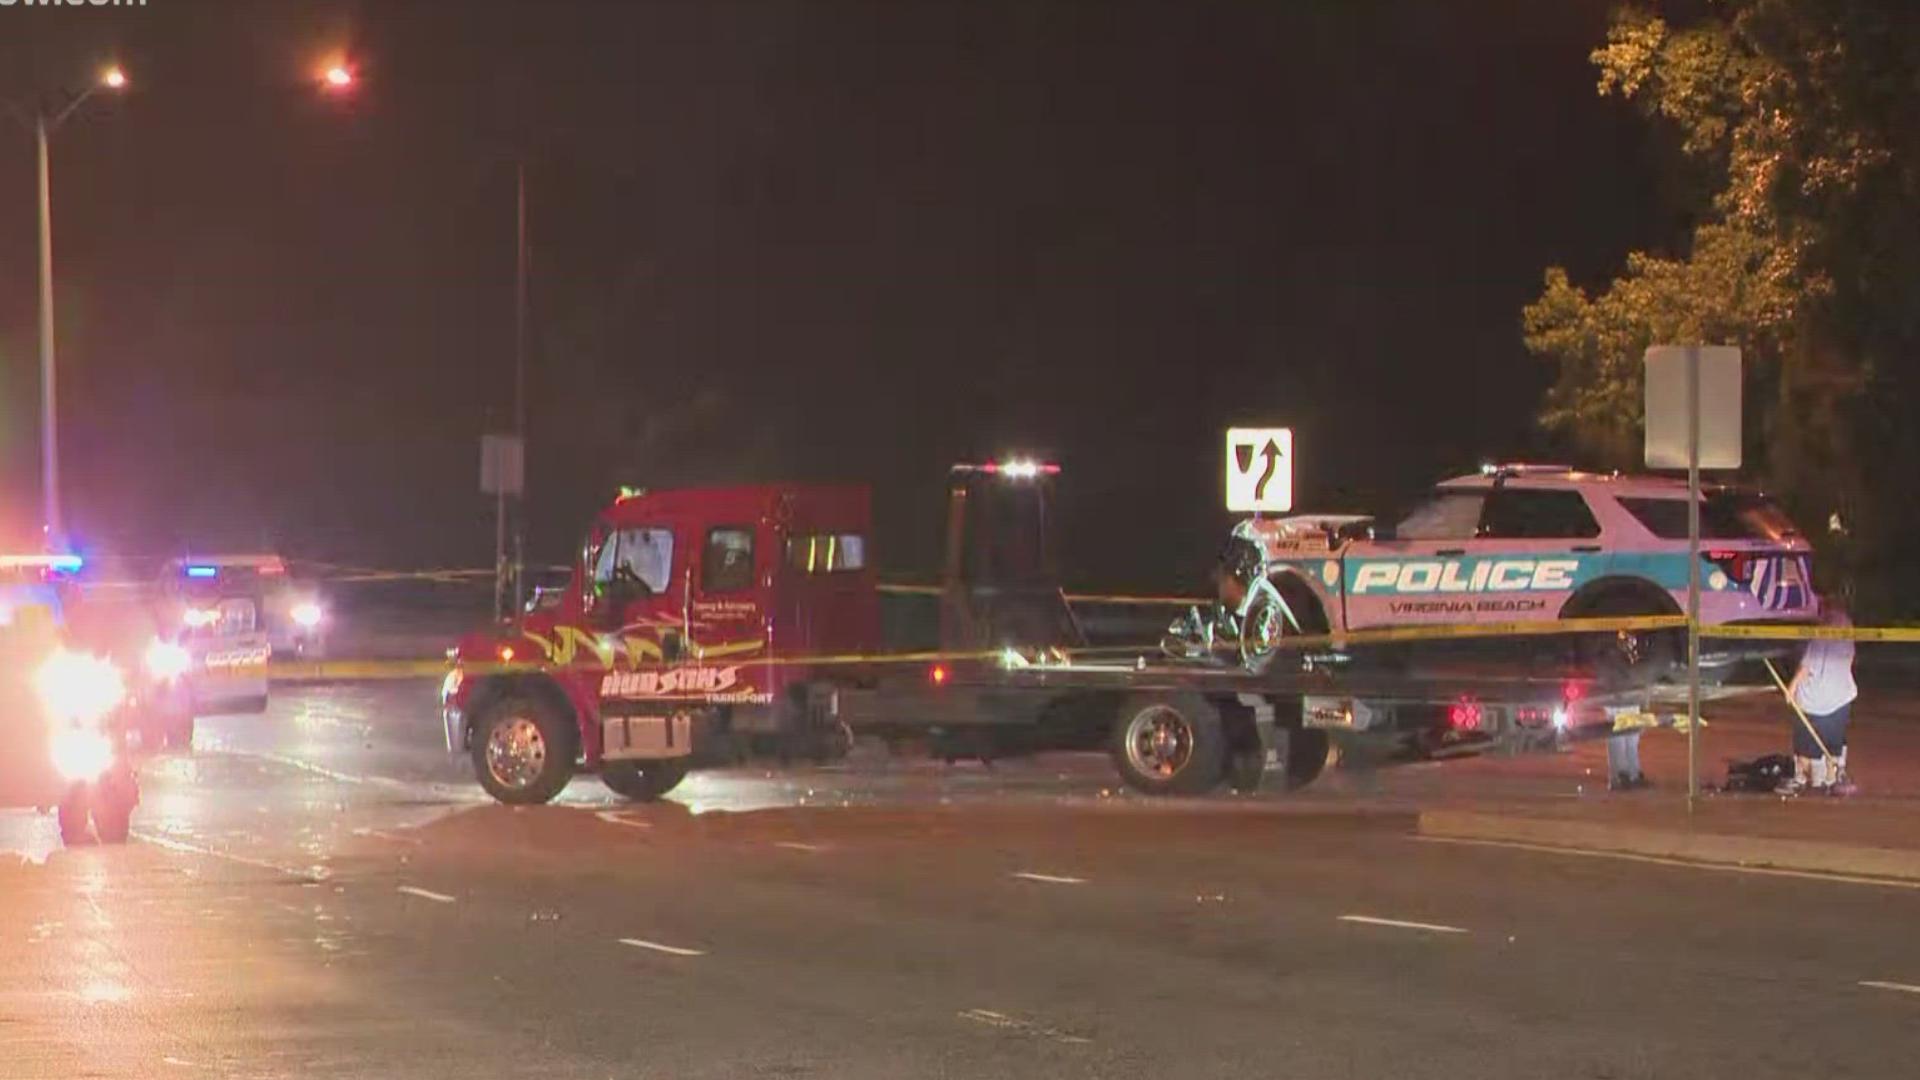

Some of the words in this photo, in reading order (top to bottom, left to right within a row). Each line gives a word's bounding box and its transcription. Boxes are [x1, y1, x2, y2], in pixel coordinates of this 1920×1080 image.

[1352, 560, 1578, 593] POLICE
[1388, 601, 1472, 615] VIRGINIA
[1477, 600, 1546, 612] BEACH
[705, 693, 774, 704] TRANSPORT
